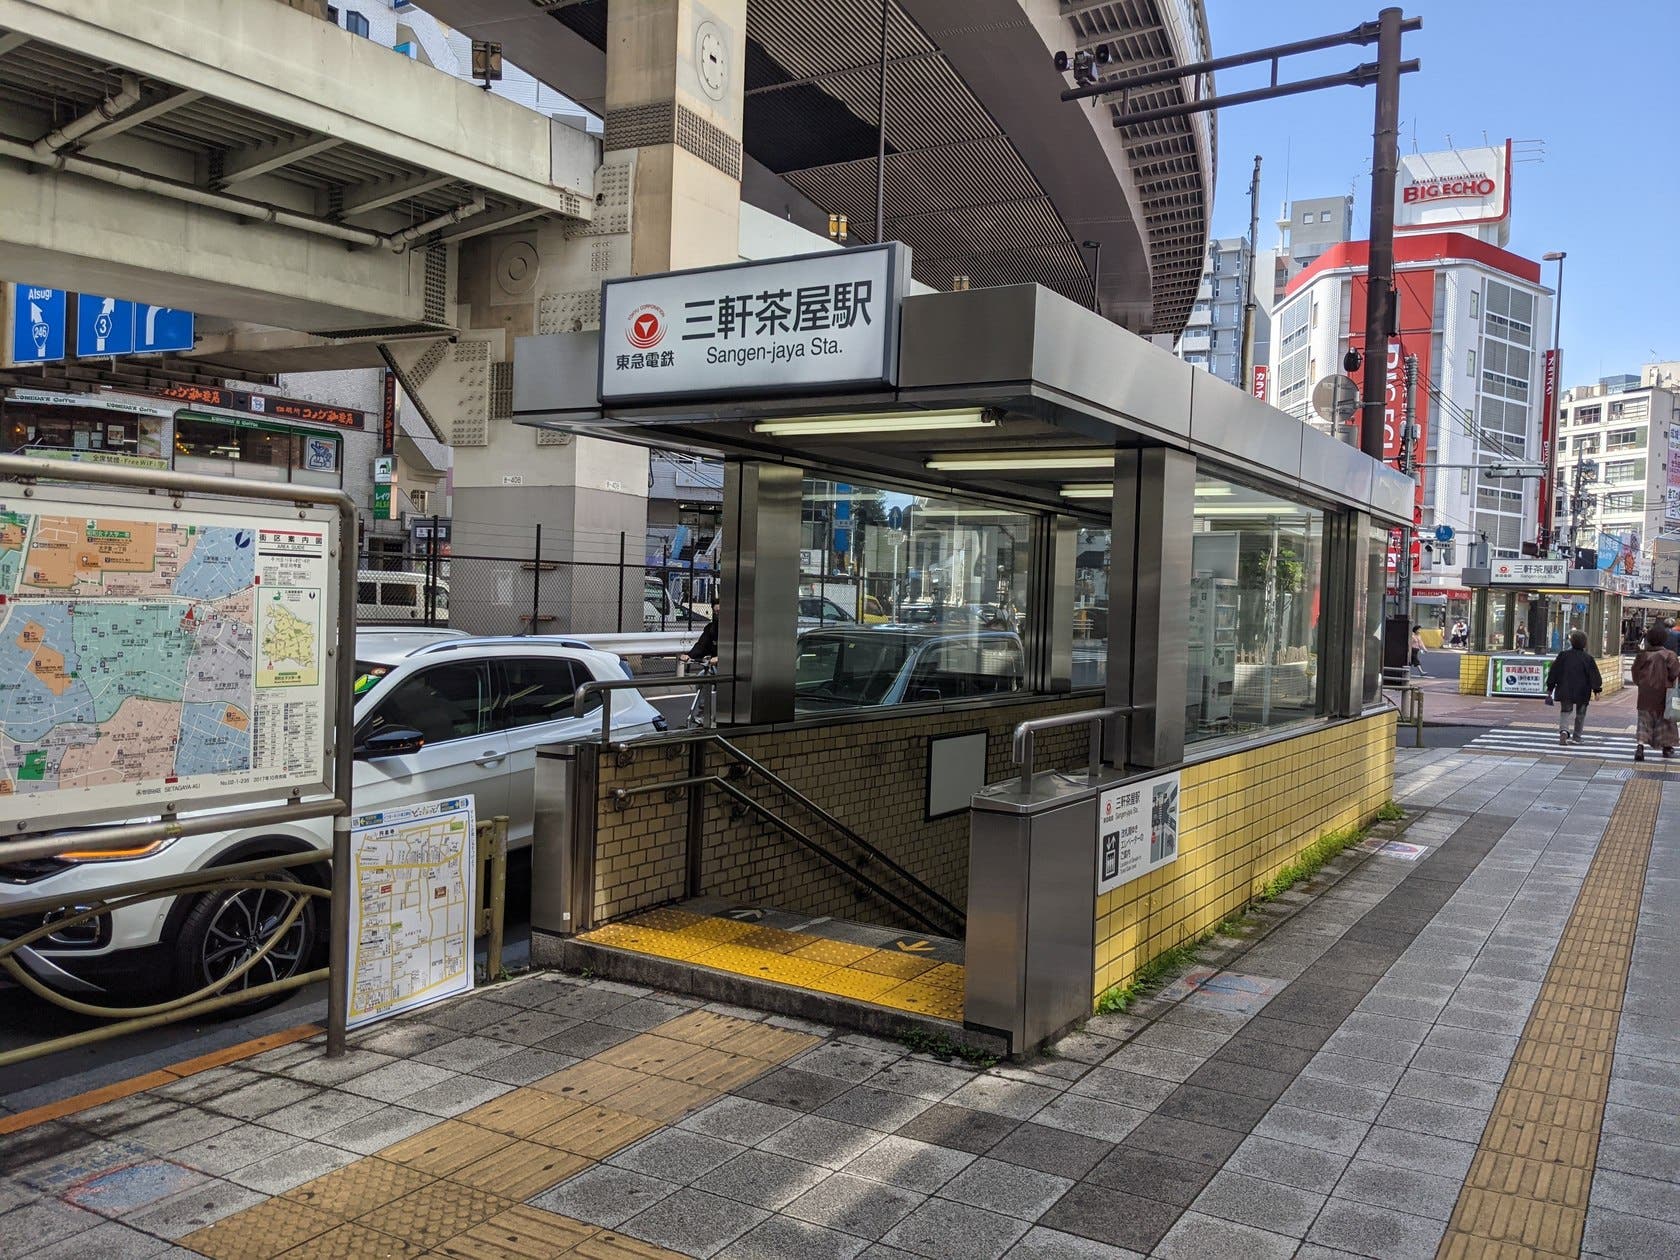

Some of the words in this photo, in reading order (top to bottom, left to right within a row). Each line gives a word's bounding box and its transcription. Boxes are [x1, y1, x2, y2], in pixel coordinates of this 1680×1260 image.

[1403, 185, 1438, 203] BIG
[1442, 178, 1495, 196] ECHO
[28, 288, 53, 301] Atsugi
[682, 279, 872, 340] 三軒茶屋駅
[34, 326, 47, 338] 246
[100, 319, 107, 334] 3
[706, 341, 805, 367] Sangen-jaya
[811, 337, 843, 356] Sta.
[616, 350, 675, 371] 東急電鉄
[375, 492, 390, 500] レイク
[1513, 564, 1564, 574] 三軒茶屋駅
